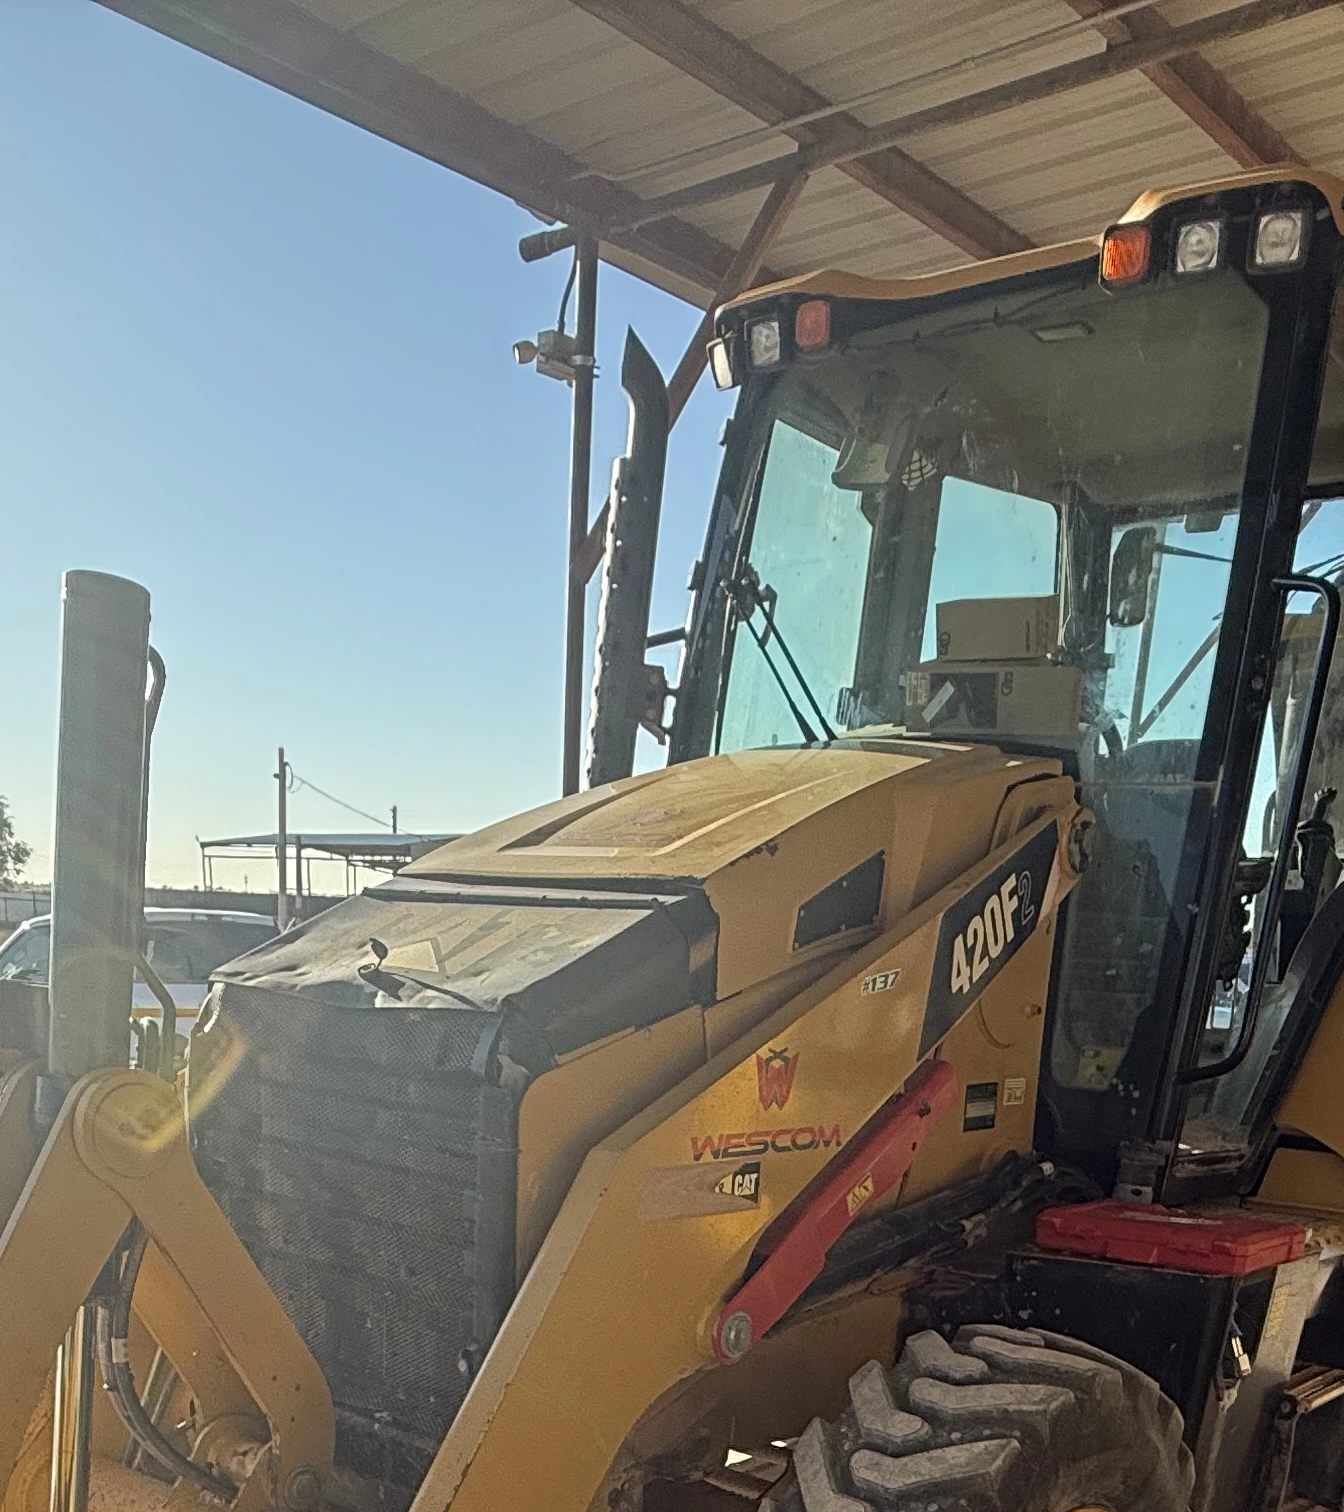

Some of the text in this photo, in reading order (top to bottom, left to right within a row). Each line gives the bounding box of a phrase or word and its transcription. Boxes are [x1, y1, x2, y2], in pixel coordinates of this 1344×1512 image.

[862, 970, 901, 994] #137
[691, 1124, 842, 1162] WESCOM
[734, 1172, 758, 1196] CAT
